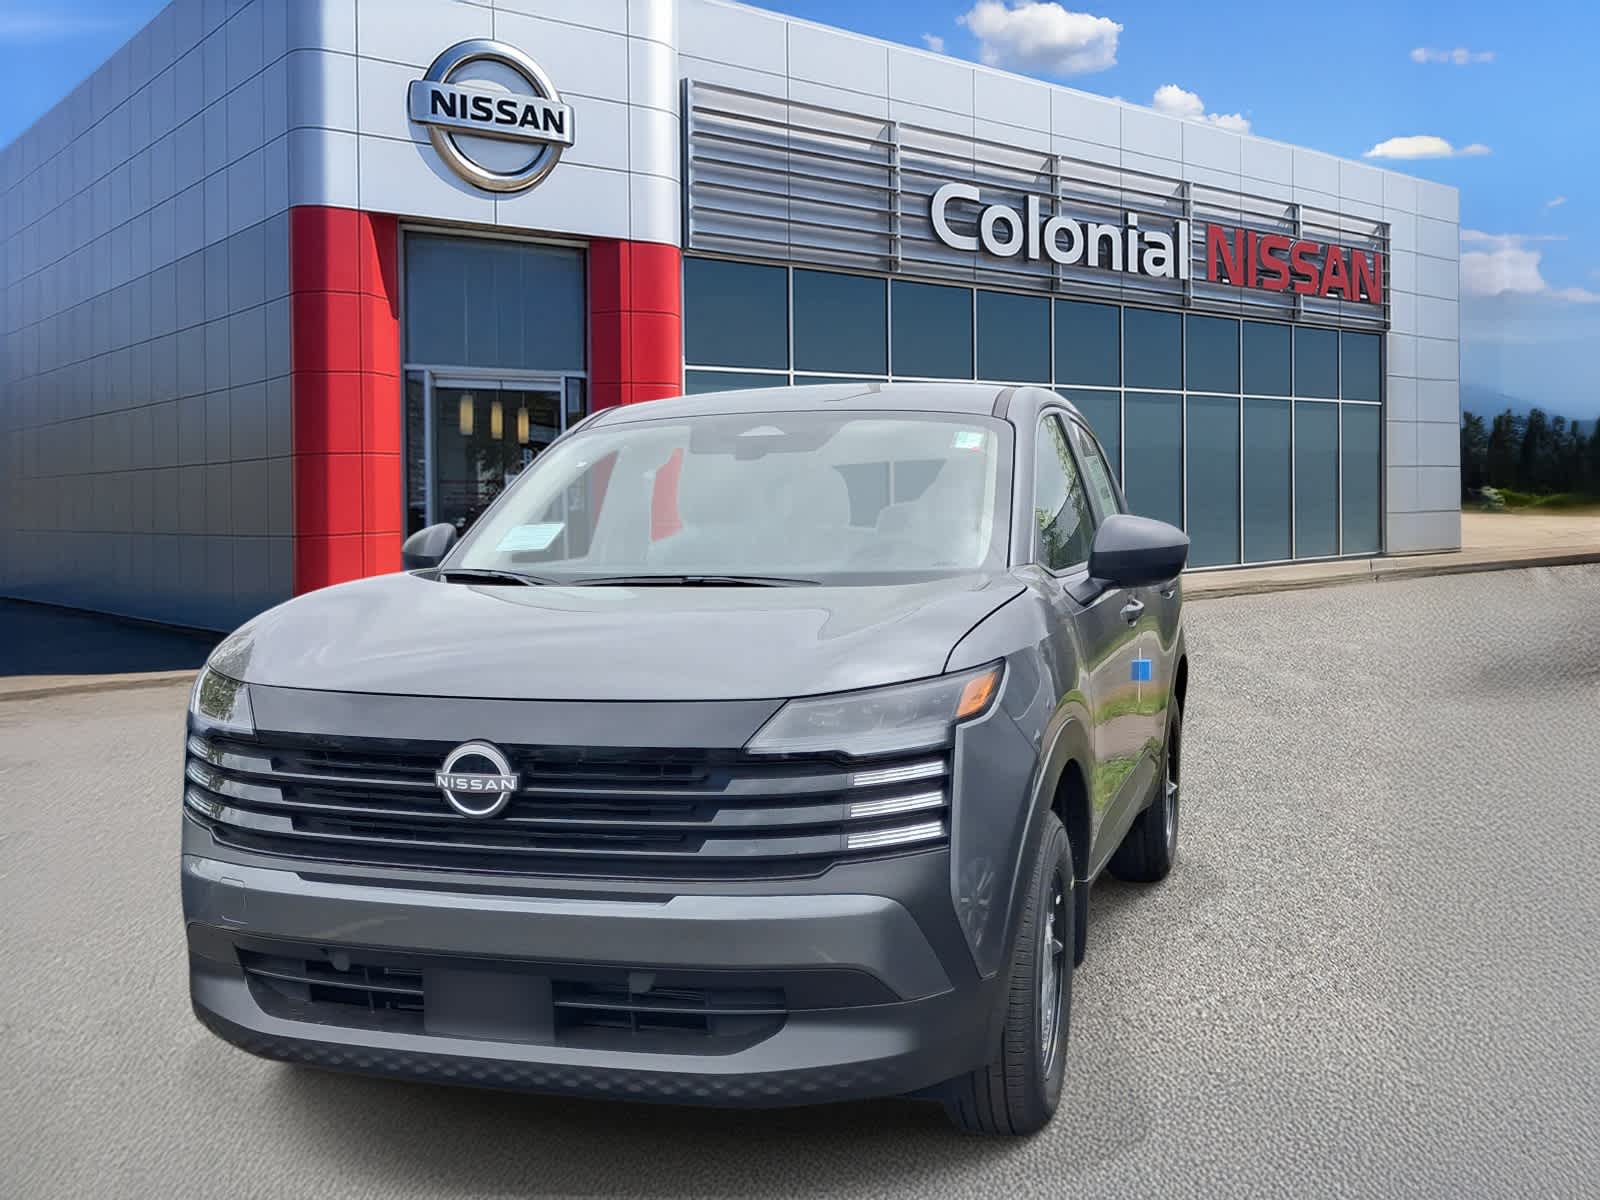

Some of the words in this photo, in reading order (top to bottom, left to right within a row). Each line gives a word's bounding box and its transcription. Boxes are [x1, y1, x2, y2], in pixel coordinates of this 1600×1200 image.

[431, 90, 564, 134] NISSAN
[931, 183, 1188, 280] Colonial
[1206, 223, 1383, 304] NISSAN
[437, 775, 515, 790] NISSAN
